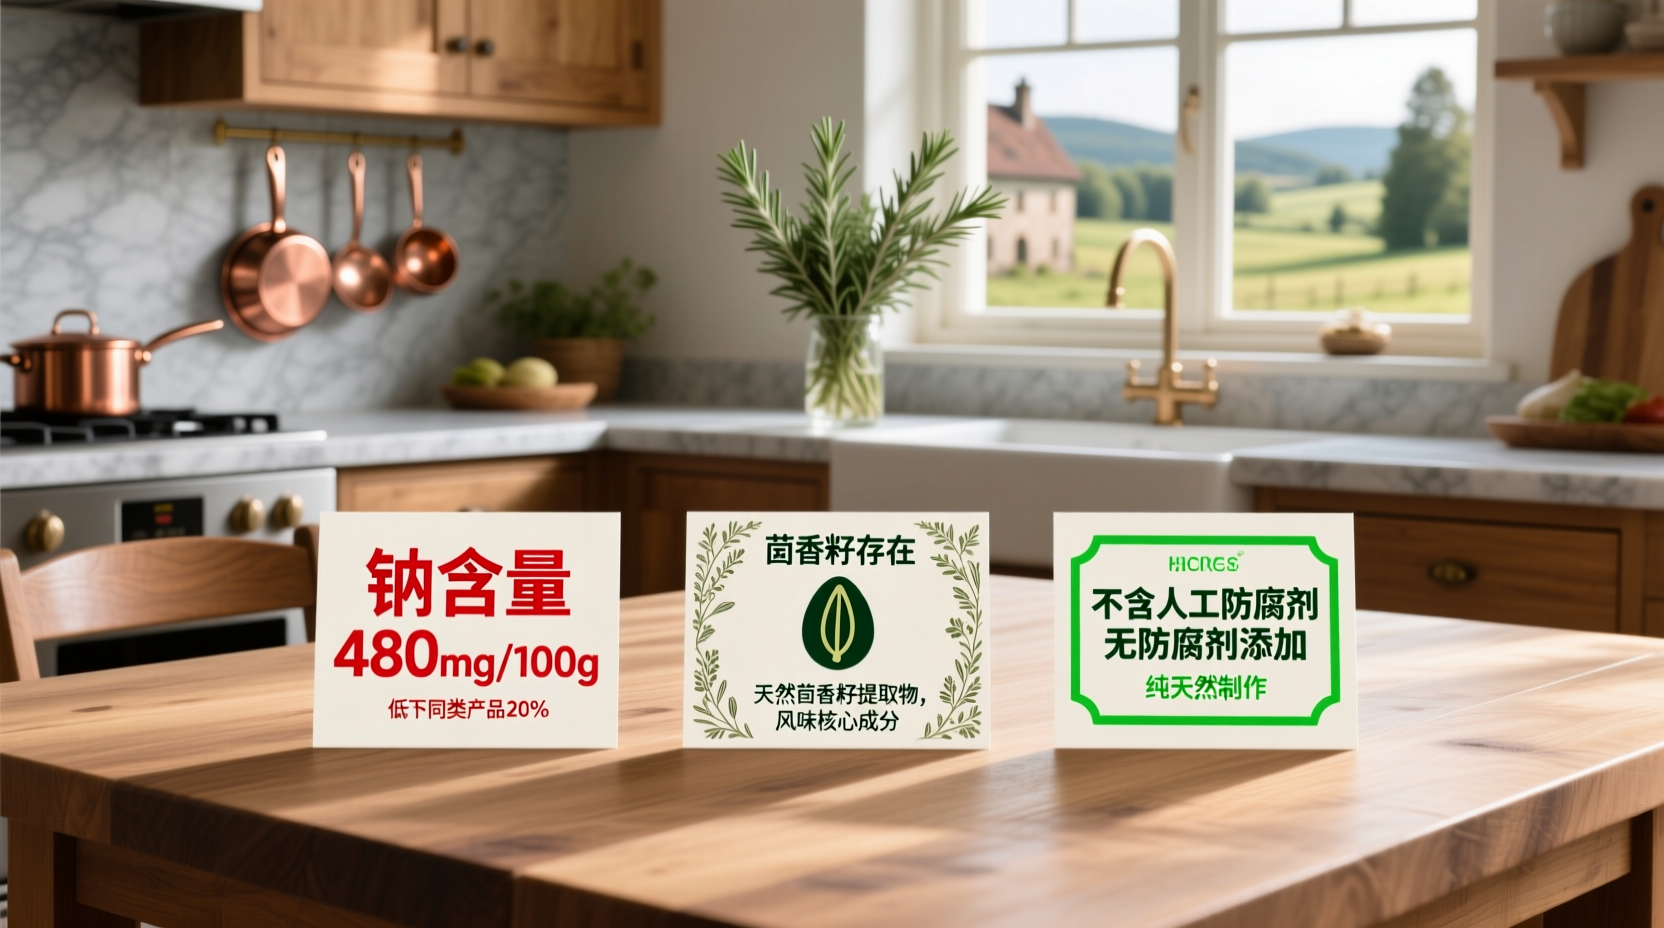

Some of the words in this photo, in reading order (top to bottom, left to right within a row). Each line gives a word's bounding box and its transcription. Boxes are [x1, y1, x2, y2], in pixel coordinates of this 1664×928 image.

[366, 547, 571, 618] 钠含量
[1091, 586, 1319, 621] 不含人工防腐剂
[334, 629, 599, 687] 480mg/100g
[1104, 626, 1307, 661] 无防腐剂添加
[1145, 674, 1267, 701] 纯天然制作
[775, 709, 900, 732] 风味核心成分
